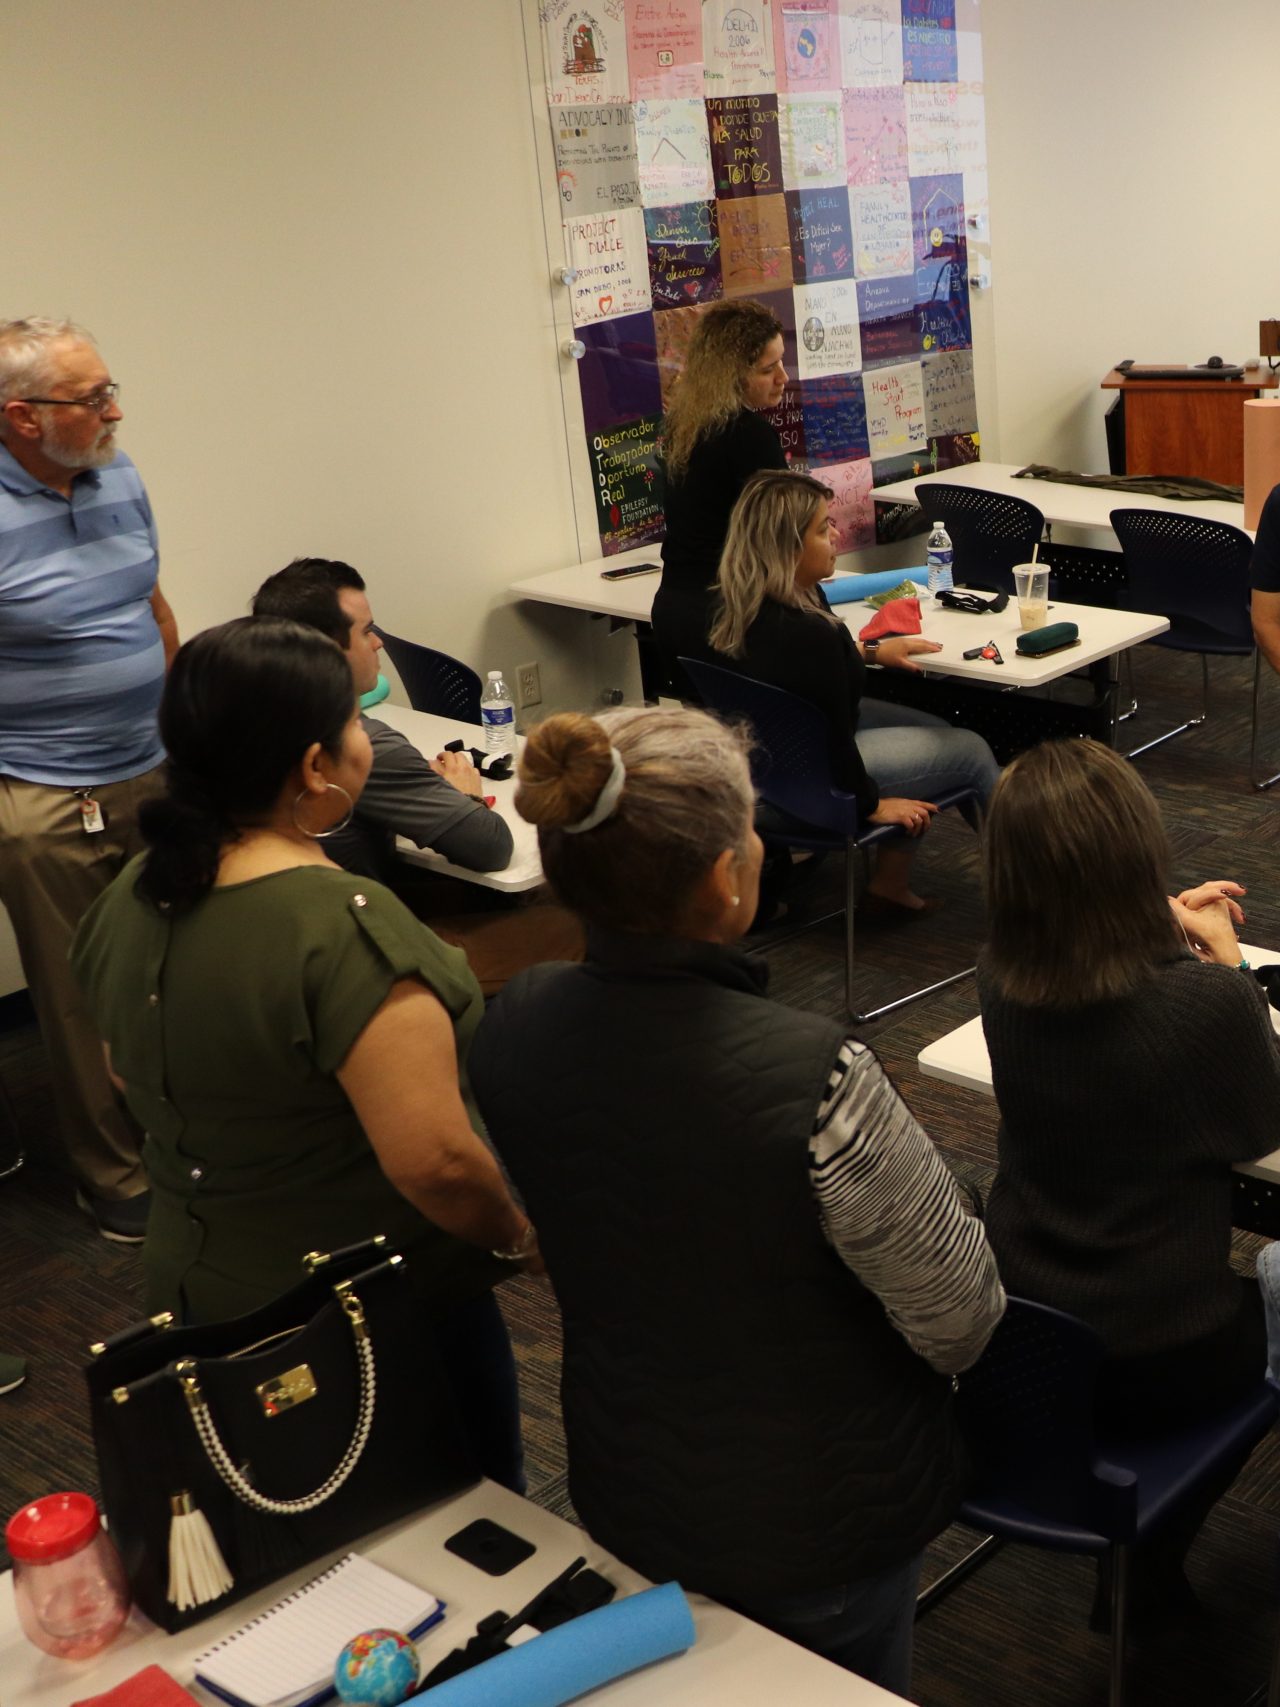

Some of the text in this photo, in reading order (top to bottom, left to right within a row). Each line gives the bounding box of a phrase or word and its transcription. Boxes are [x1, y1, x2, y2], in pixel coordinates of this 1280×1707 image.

[560, 107, 613, 127] ADVOCACY
[734, 147, 760, 161] PARA
[723, 162, 771, 185] TODOS
[572, 218, 616, 241] PROJECT
[872, 375, 899, 395] Health
[594, 419, 655, 451] Observador
[596, 439, 655, 471] Trabajador
[599, 462, 647, 490] Oportuno
[601, 485, 625, 506] Real
[621, 497, 648, 515] EPILEPSY
[622, 504, 659, 525] FOUNDATION
